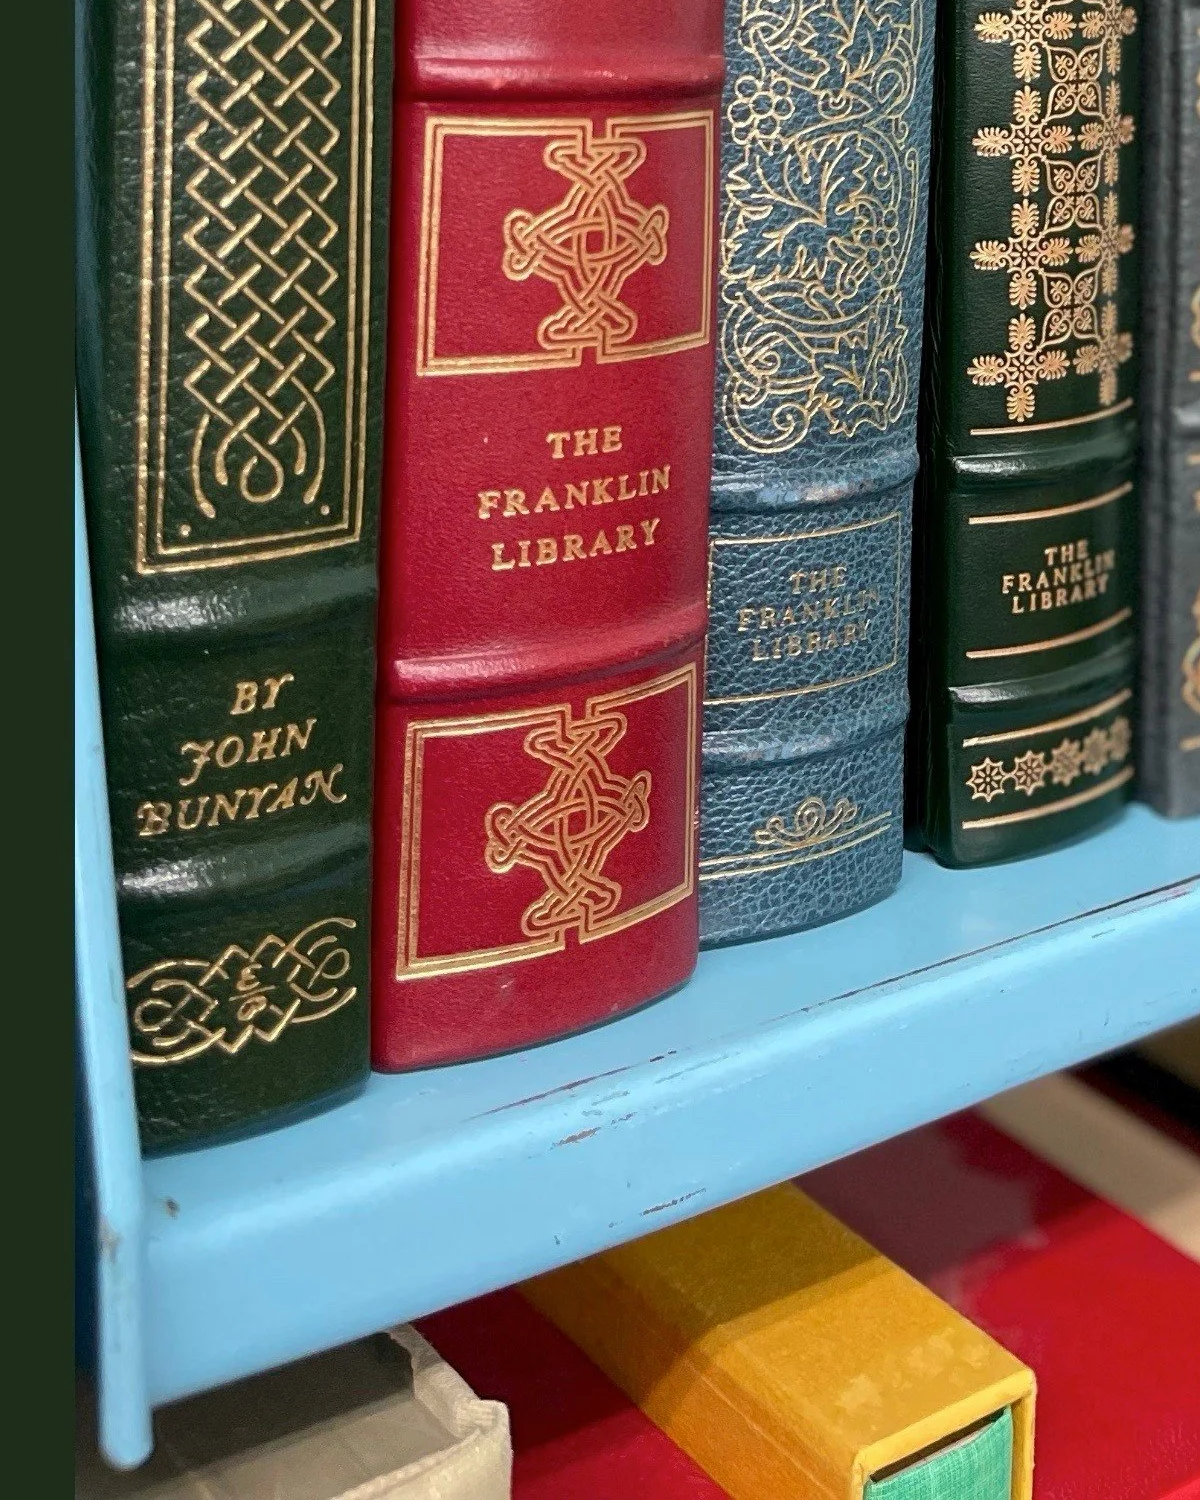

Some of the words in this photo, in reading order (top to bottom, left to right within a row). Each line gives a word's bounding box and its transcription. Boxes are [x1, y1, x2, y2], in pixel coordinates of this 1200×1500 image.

[545, 425, 623, 459] THE
[477, 463, 671, 520] FRANKLIN
[491, 517, 661, 571] LIBRARY
[1044, 539, 1089, 566] THE
[789, 565, 847, 595] THE
[1002, 548, 1116, 594] FRANKLIN
[737, 588, 880, 631] FRANKLIN
[1012, 572, 1110, 614] LIBRARY
[752, 618, 871, 662] LIBRARY
[229, 673, 295, 715] BY
[178, 717, 318, 787] JOHN
[136, 762, 348, 837] BUNYAN
